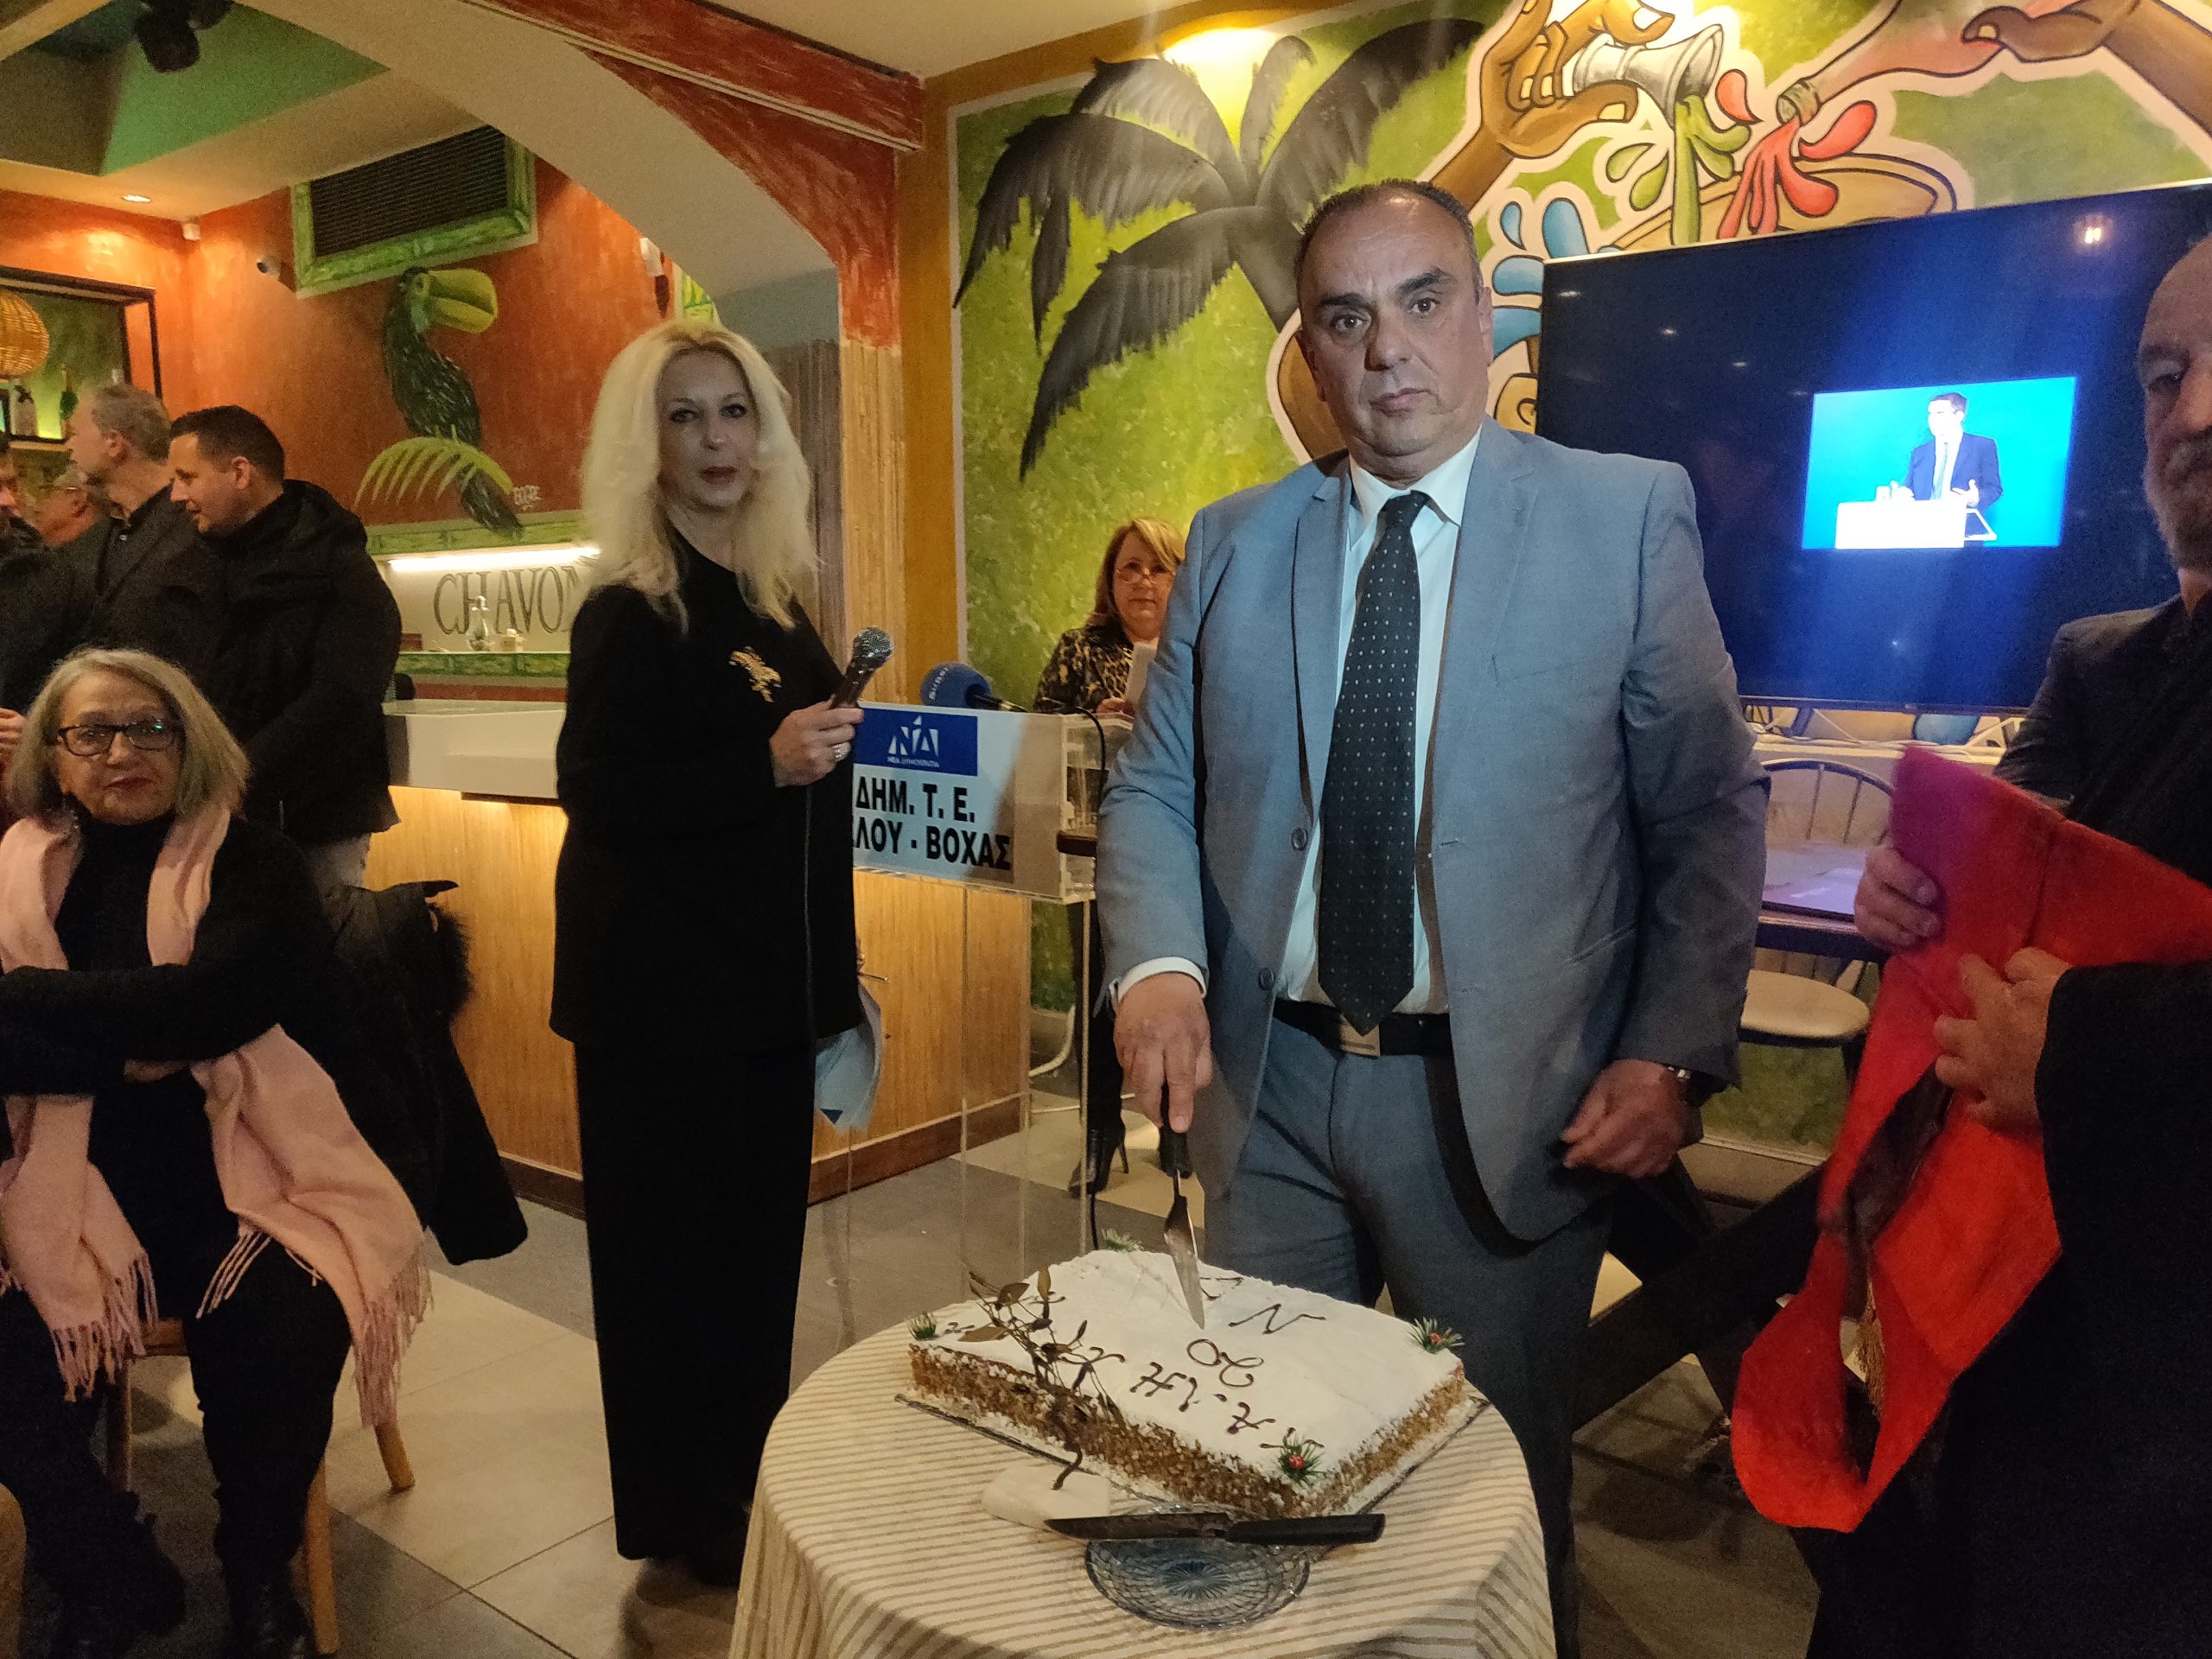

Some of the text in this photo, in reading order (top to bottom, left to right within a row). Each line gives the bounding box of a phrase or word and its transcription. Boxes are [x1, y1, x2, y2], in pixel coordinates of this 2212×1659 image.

[855, 776, 915, 815] ΔΗΜ.
[852, 816, 903, 854] ΛΟΥ
[926, 825, 1012, 870] ΒΟΧΑΣ
